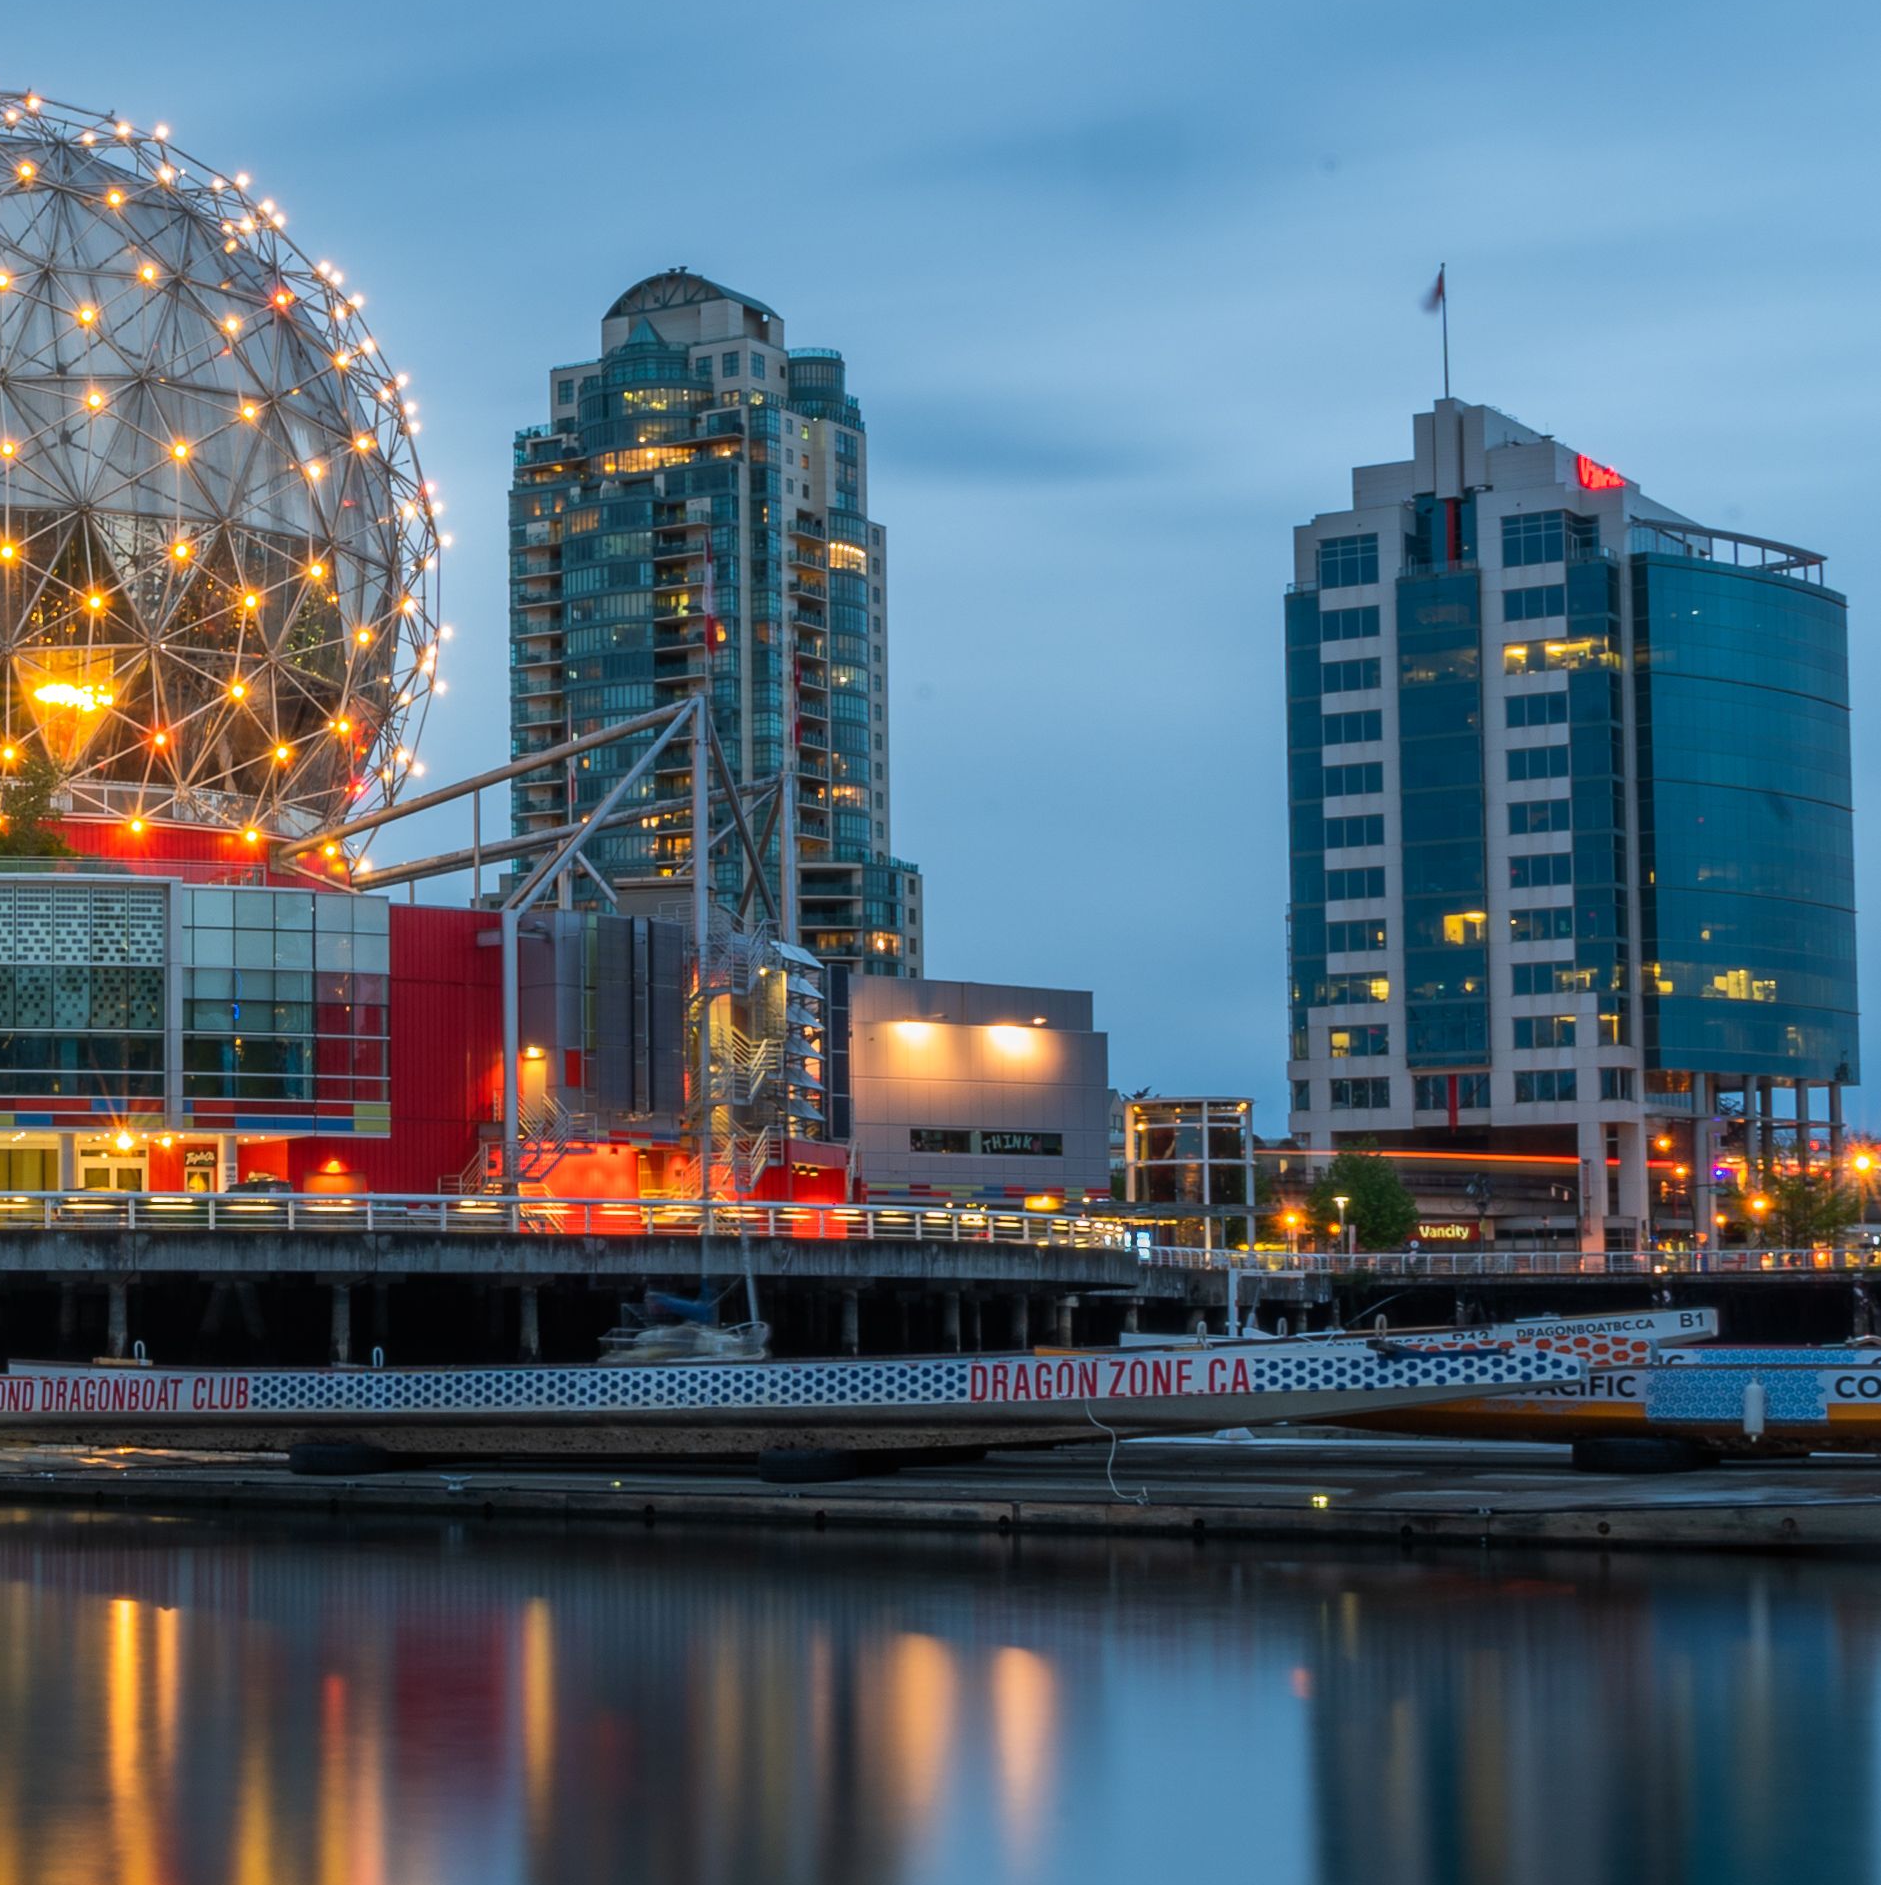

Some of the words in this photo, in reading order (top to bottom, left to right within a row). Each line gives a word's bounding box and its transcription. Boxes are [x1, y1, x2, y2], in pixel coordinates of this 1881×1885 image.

[982, 1134, 1032, 1153] THINK
[1419, 1224, 1469, 1240] Vancity
[1516, 1319, 1655, 1338] DRAGONBOATBC.CA
[1680, 1312, 1704, 1328] B1
[970, 1361, 1098, 1401] DRAGON
[1108, 1358, 1251, 1398] ZONE.CA
[41, 1376, 183, 1411] DRAGONBOAT
[193, 1376, 249, 1410] CLUB
